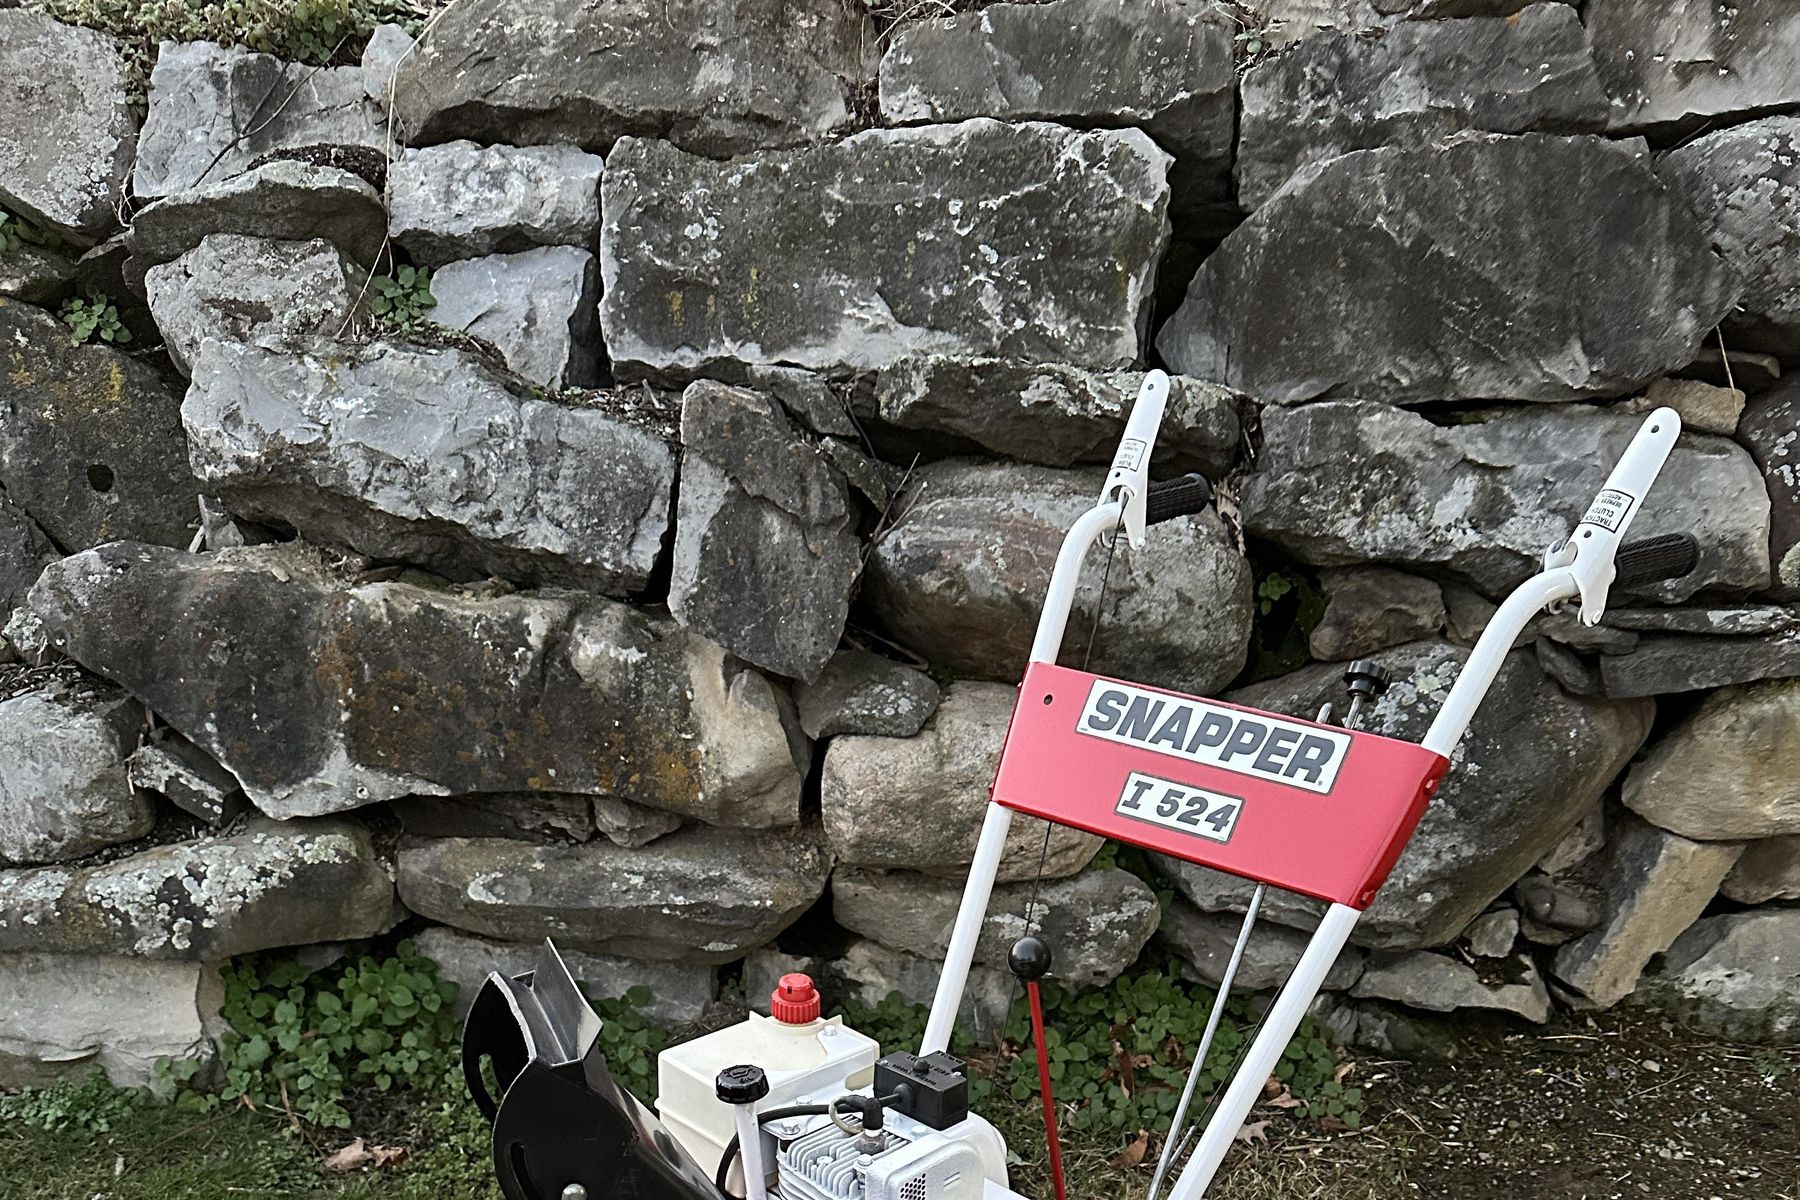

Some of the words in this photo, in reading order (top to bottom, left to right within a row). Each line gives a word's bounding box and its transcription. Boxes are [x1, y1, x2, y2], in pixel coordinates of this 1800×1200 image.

[1087, 689, 1336, 784] SNAPPER
[1122, 780, 1154, 810] I
[1156, 788, 1237, 833] 524
